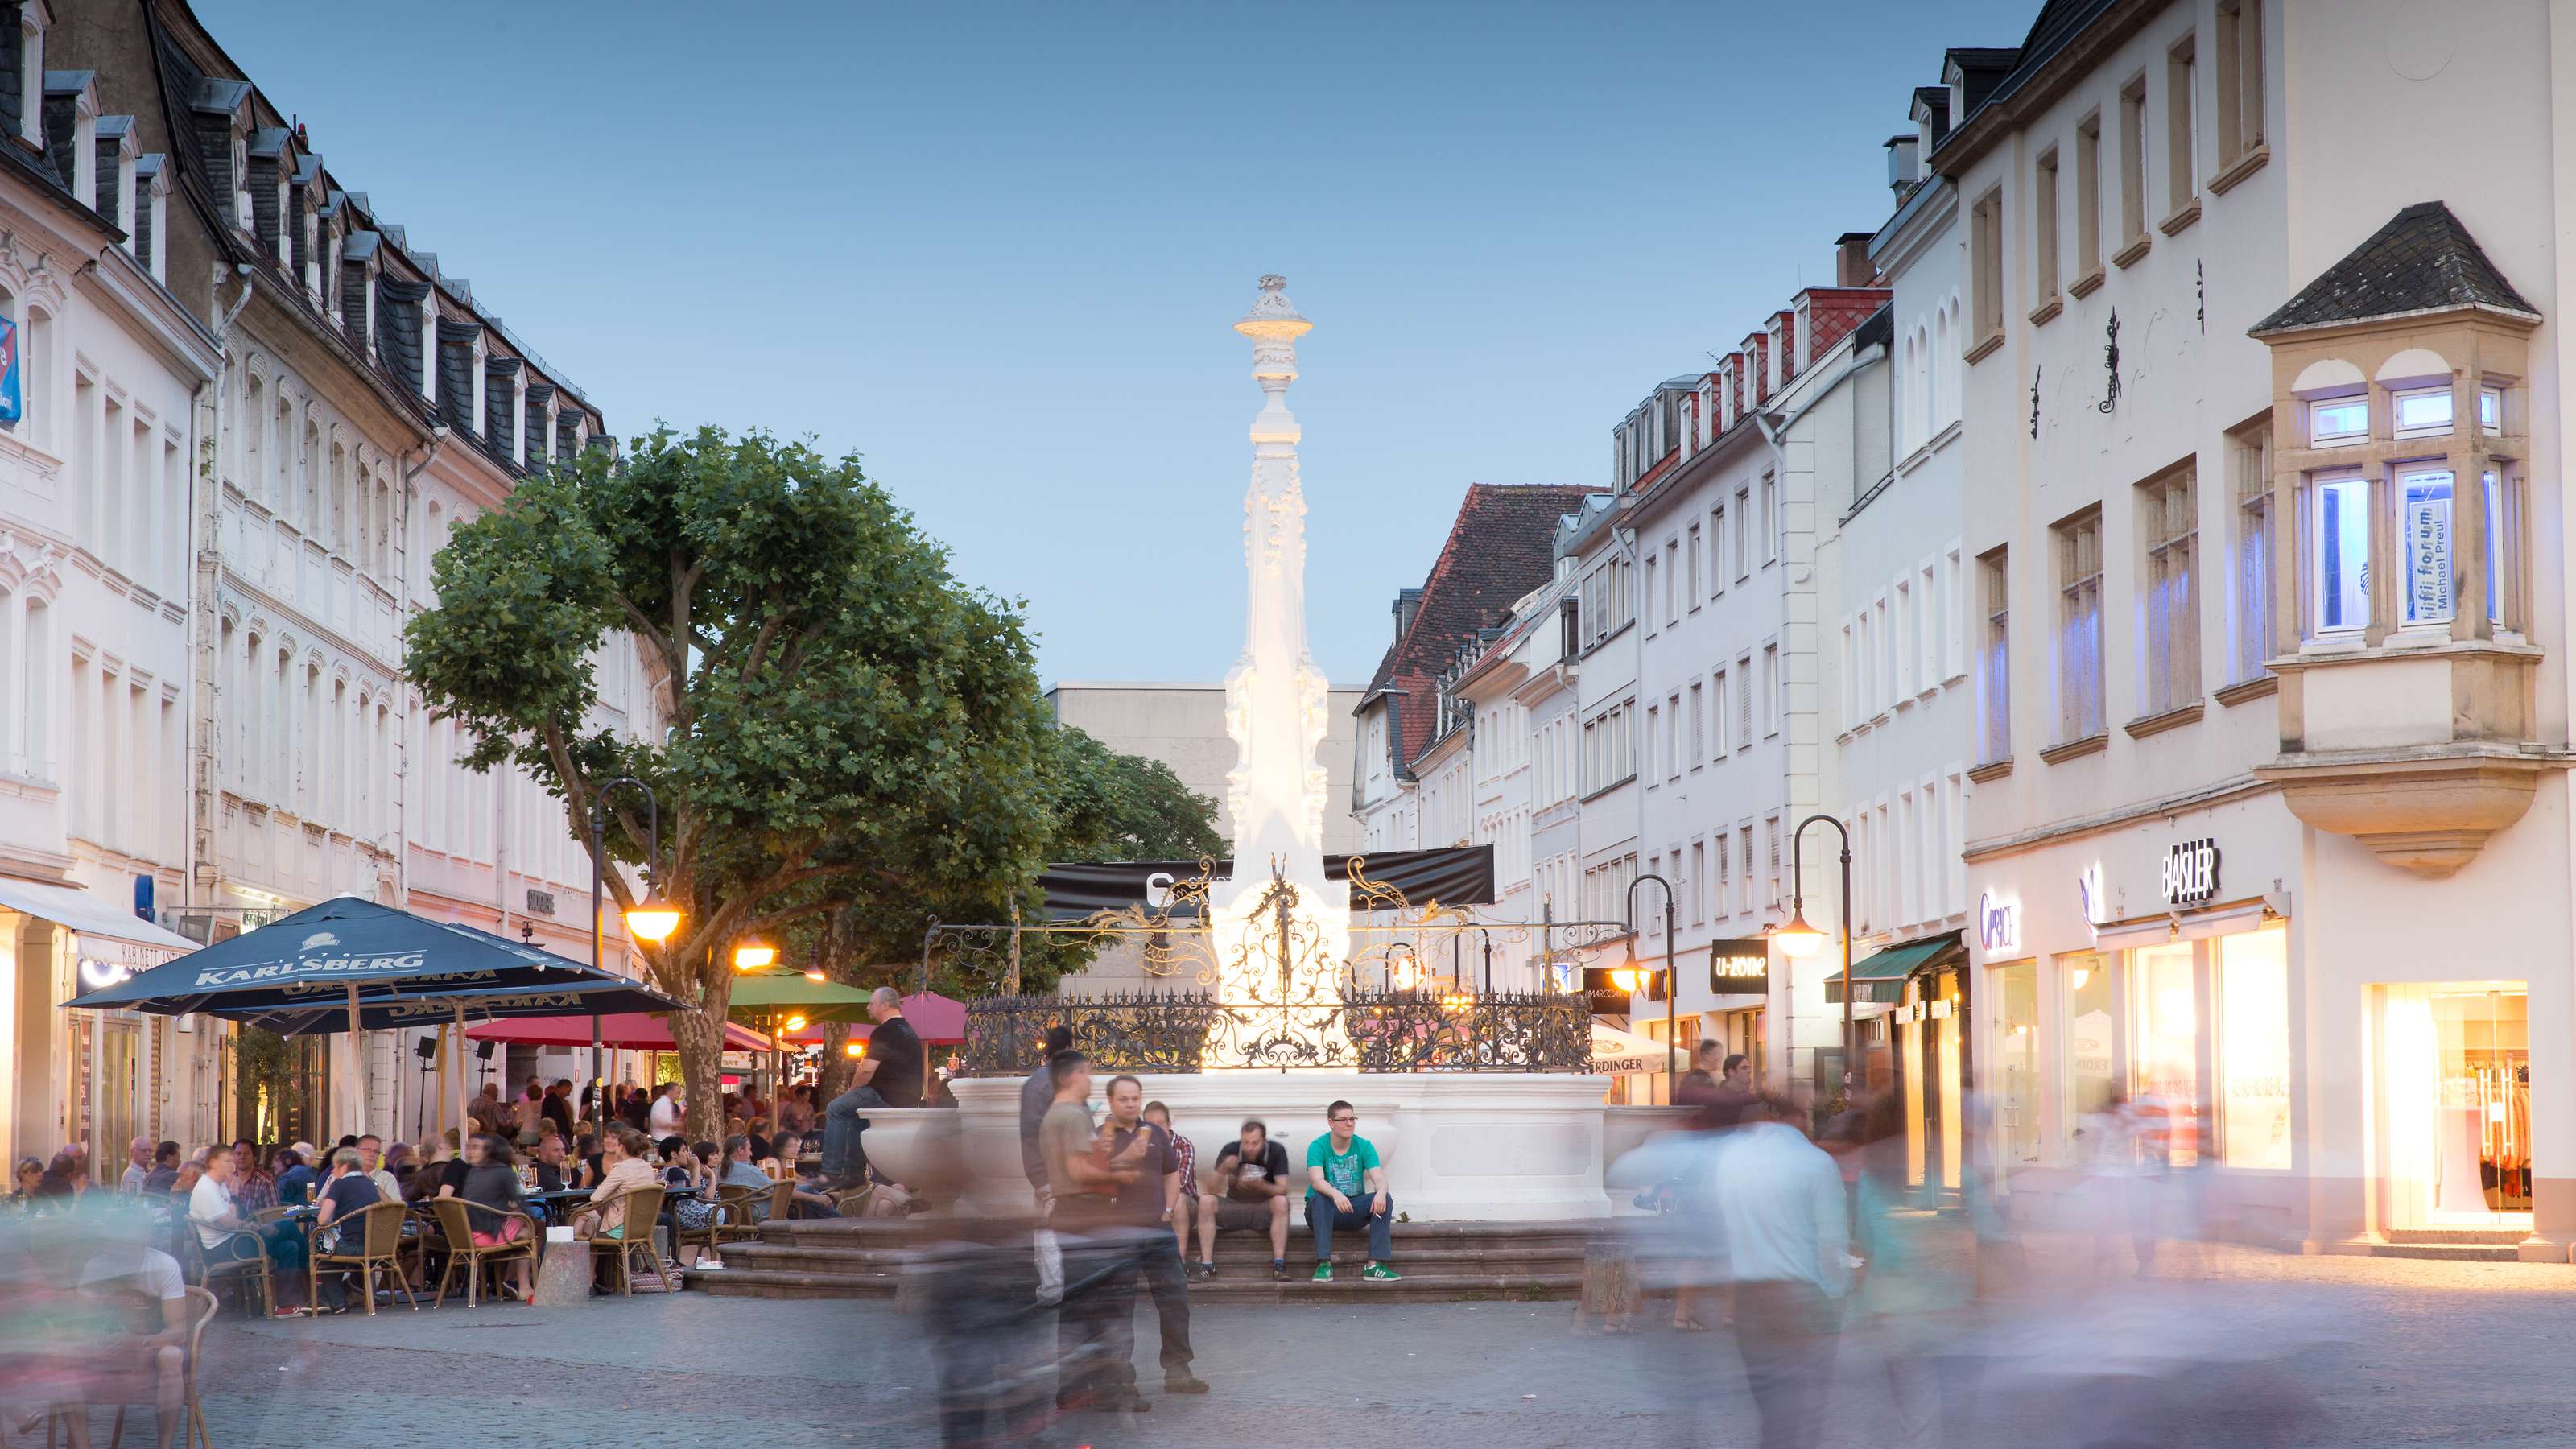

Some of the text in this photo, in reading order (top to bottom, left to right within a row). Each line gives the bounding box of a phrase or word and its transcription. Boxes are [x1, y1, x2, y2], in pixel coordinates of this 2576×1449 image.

[2417, 510, 2434, 575] forum
[2434, 520, 2447, 609] Michael Preul
[2162, 845, 2214, 898] BASLER
[122, 944, 159, 967] KABINETT
[194, 953, 424, 986] KARLSBERG
